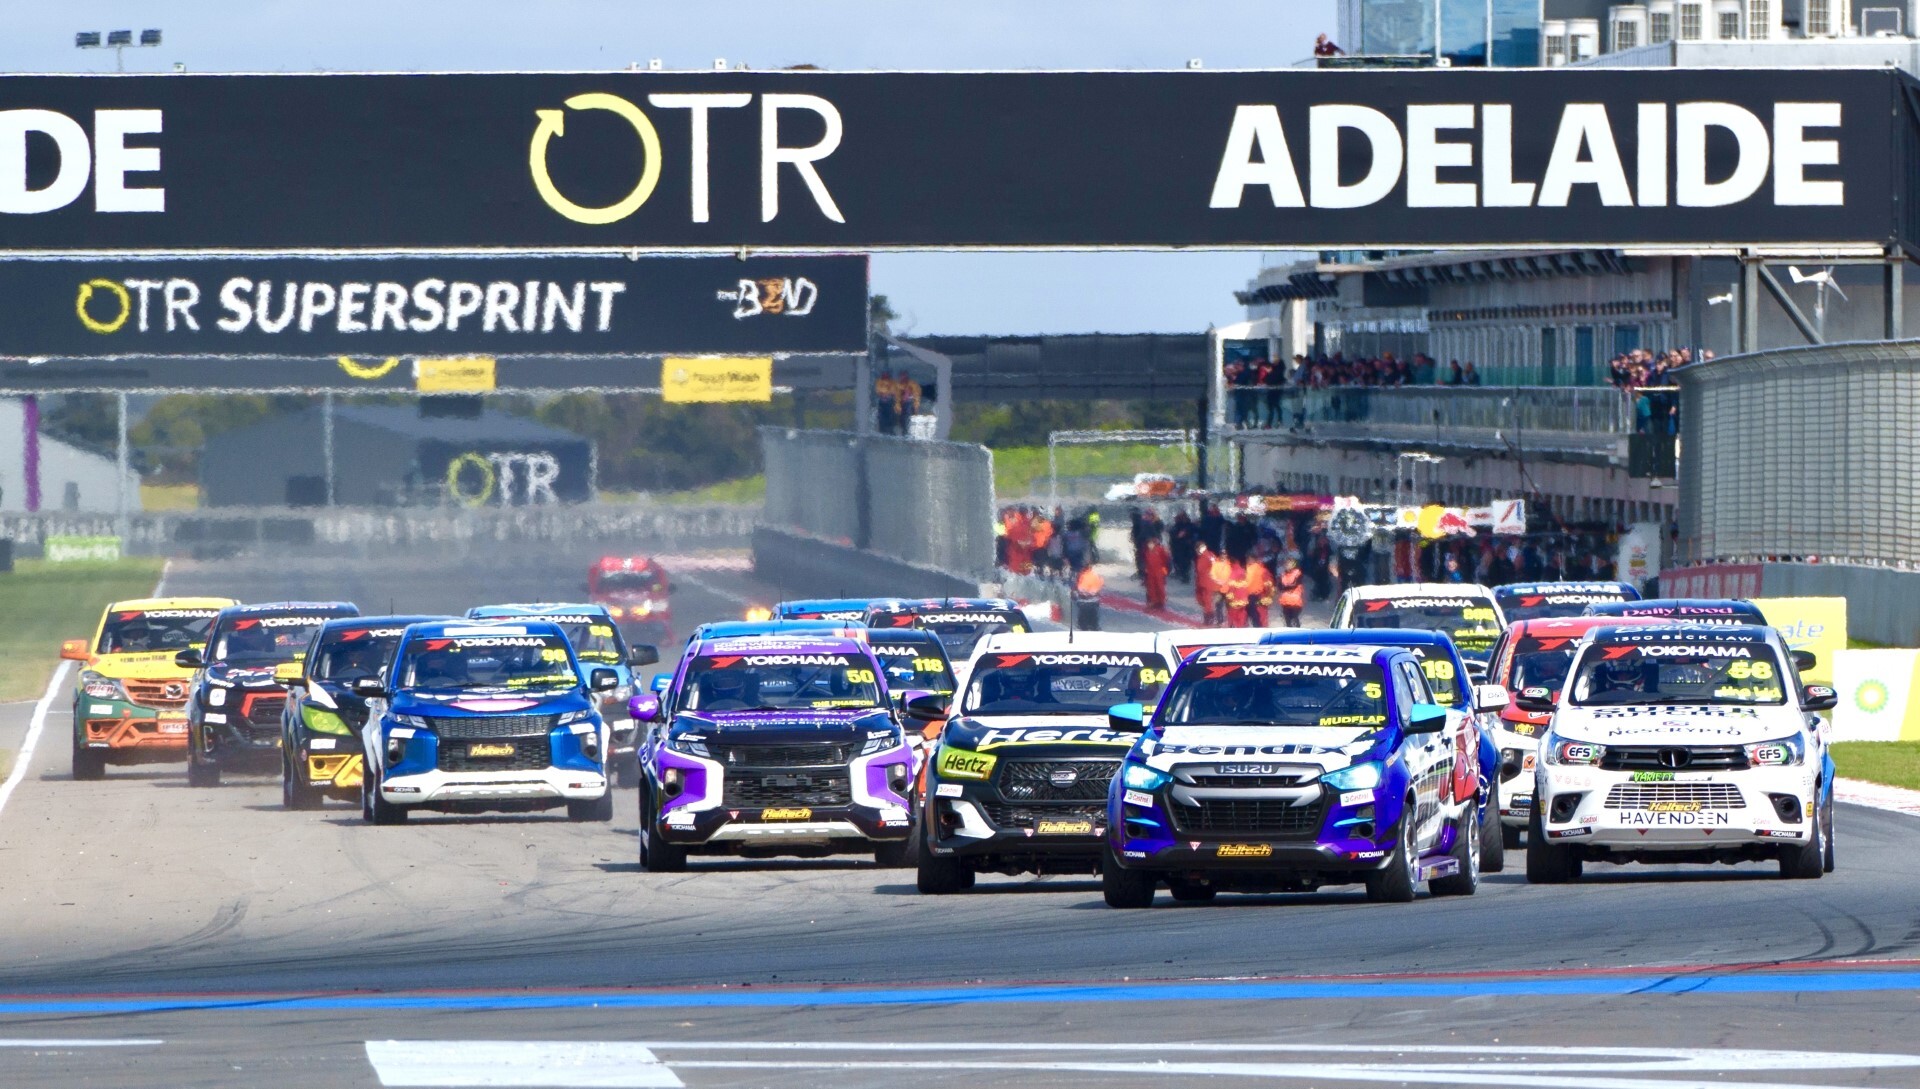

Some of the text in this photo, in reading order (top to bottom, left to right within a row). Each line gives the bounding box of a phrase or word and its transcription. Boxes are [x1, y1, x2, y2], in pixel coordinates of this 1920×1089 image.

[0, 108, 165, 213] DE
[529, 92, 845, 224] OTR
[1209, 102, 1845, 209] ADELAIDE
[76, 278, 626, 334] OTR SUPERSPRINT
[447, 451, 560, 506] OTR
[1391, 599, 1474, 608] YOKOHAMA
[1545, 595, 1625, 604] YOKOHAMA
[919, 613, 1007, 624] YOKOHAMA
[1782, 619, 1825, 639] ate
[453, 637, 546, 647] YOKOHAMA
[1613, 635, 1654, 643] 1300
[1715, 635, 1754, 643] LAW
[1638, 645, 1751, 658] YOKOHAMA
[743, 655, 850, 666] YOKOHAMA
[912, 658, 944, 673] 118
[1032, 654, 1144, 668] YOKOHAMA
[846, 669, 875, 684] 50
[1140, 668, 1171, 685] 64
[1242, 665, 1357, 678] YOKOHAMA
[1364, 682, 1382, 699] 5
[1319, 715, 1386, 726] MUDFLAP
[978, 730, 1143, 745] Hertz
[1150, 745, 1348, 756] Bendix
[1568, 747, 1591, 758] EFS
[1758, 748, 1781, 759] EFS
[945, 754, 987, 773] Hertz
[1220, 764, 1273, 774] ISUZU
[1633, 772, 1675, 783] VARIETY
[1654, 802, 1702, 811] Haltech
[1037, 821, 1092, 834] Haltech
[1560, 828, 1586, 836] YOKOHAMA
[1770, 830, 1797, 838] YOKOHAMA
[1217, 844, 1272, 857] Haltech
[1358, 850, 1385, 858] YOKOHAMA
